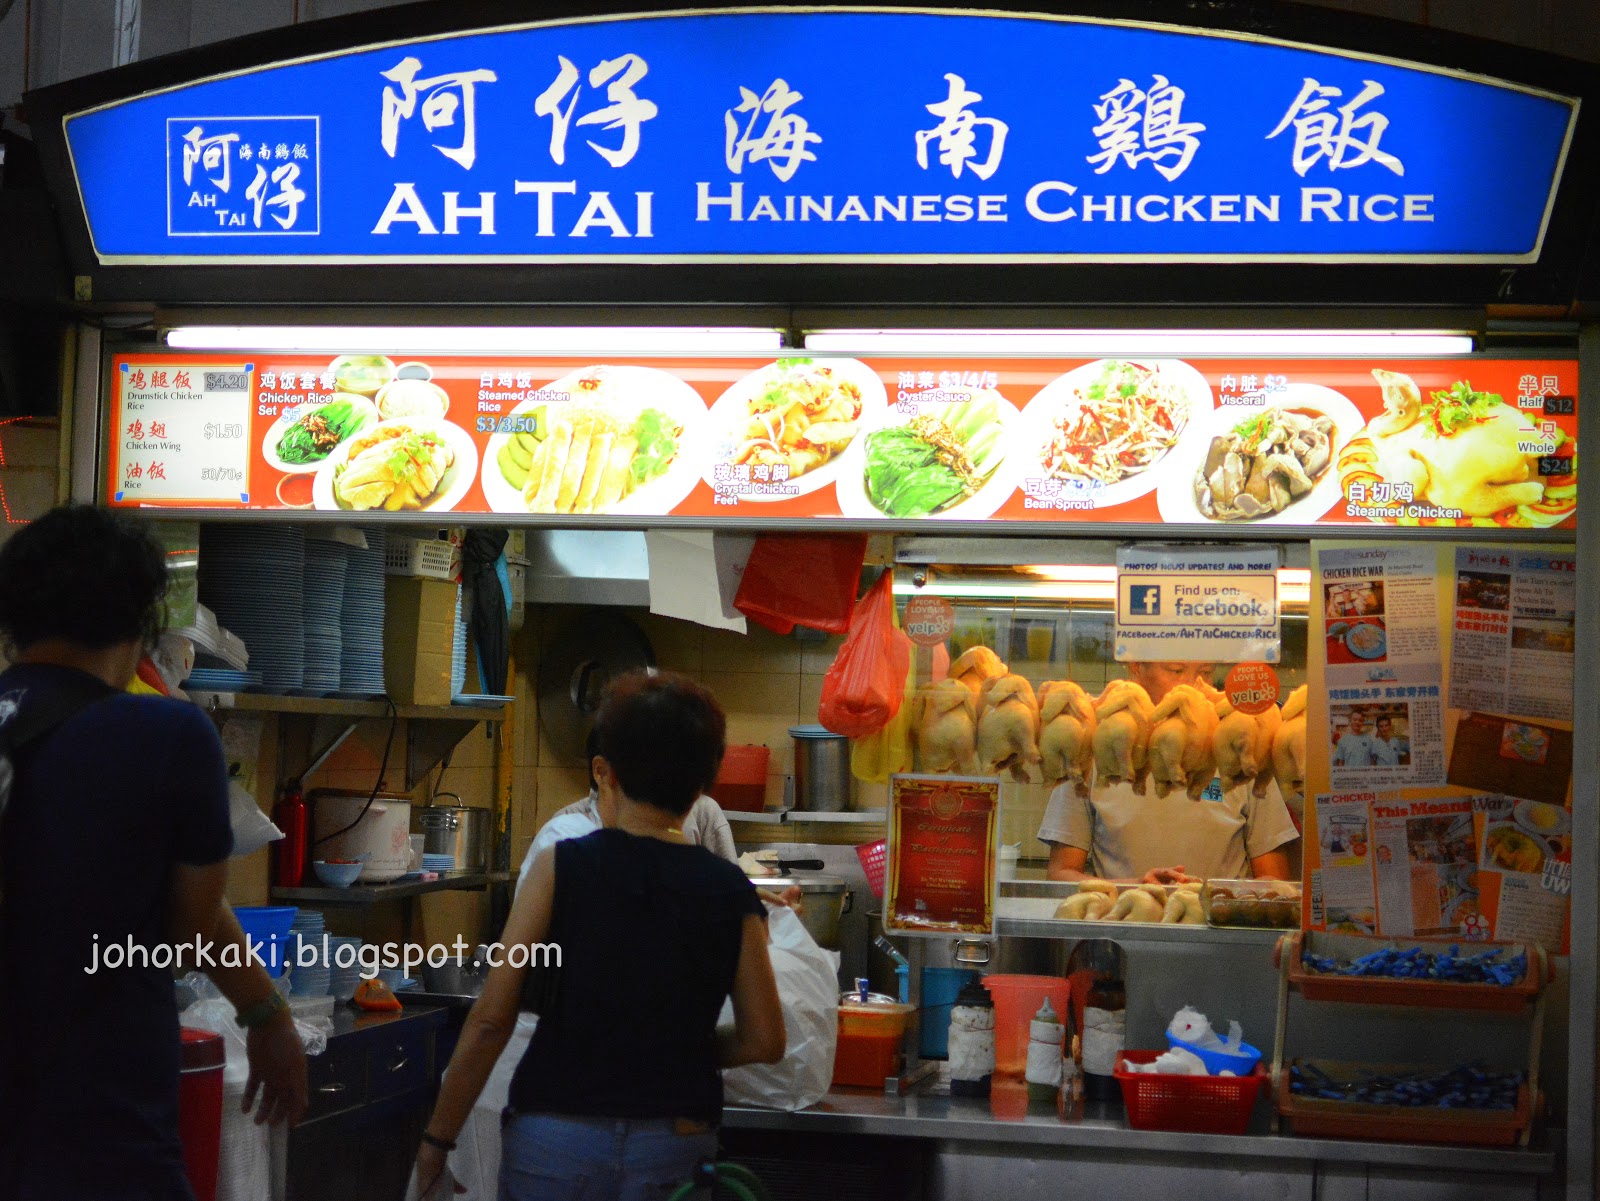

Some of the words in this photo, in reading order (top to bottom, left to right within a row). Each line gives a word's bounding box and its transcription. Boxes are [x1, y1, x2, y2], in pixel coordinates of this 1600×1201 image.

[371, 183, 497, 235] AH
[515, 180, 654, 238] TAI
[695, 182, 1008, 222] HAINANESE
[1025, 180, 1280, 223] CHICKEN
[1300, 187, 1435, 223] RICE
[128, 369, 192, 390] 鸡腿饭
[206, 373, 249, 390] $4.20
[259, 372, 336, 390] 鸡饭套餐
[480, 371, 532, 389] 白鸡饭
[897, 371, 935, 389] 油菜
[1220, 374, 1259, 393] 内脏
[1264, 373, 1287, 394] $2
[1519, 375, 1560, 396] 半只
[127, 392, 168, 400] Drumstick
[170, 392, 203, 400] Chicken
[258, 392, 304, 404] Chicken
[307, 392, 333, 404] Rice
[477, 390, 525, 401] Steamed
[526, 389, 571, 401] Chicken
[897, 391, 934, 403] Oyster
[936, 391, 971, 402] Sauce
[1219, 394, 1265, 406] Visceral
[1519, 396, 1544, 408] Half
[127, 402, 144, 410] Rice
[258, 405, 277, 416] Set
[477, 402, 502, 412] Rice
[896, 402, 918, 416] Veg
[1546, 397, 1574, 413] $12
[281, 406, 301, 423] $5
[126, 419, 168, 440] 鸡翅
[204, 422, 243, 440] $1.50
[476, 416, 537, 433] $3/3.50
[1519, 421, 1557, 441] 一只
[126, 442, 158, 450] Chicken
[160, 442, 181, 452] Wing
[1517, 442, 1555, 453] Whole
[126, 461, 166, 480] 油饭
[714, 463, 790, 481] 玻璃鸡脚
[1541, 458, 1571, 474] $24
[124, 481, 141, 489] Rice
[714, 483, 752, 495] Crystal
[754, 483, 799, 495] Chicken
[1024, 478, 1062, 497] 豆芽
[1347, 482, 1415, 503] 白切鸡
[714, 495, 738, 505] Feet
[1024, 498, 1054, 509] Bean
[1055, 498, 1095, 512] Sprout
[1346, 505, 1405, 519] Steamed
[1407, 505, 1462, 519] Chicken
[1124, 562, 1157, 571] PHOTOS!
[1188, 562, 1224, 571] UPDATES!
[1228, 563, 1244, 571] AND
[1247, 562, 1272, 571] MORE!
[1323, 568, 1351, 580] CHICKEN
[1352, 567, 1367, 578] RICE
[1367, 565, 1385, 577] WAR
[1174, 584, 1200, 596] Find
[1204, 587, 1218, 596] us
[907, 622, 936, 636] yelp
[1237, 665, 1264, 673] PEOPLE
[1233, 673, 1255, 682] LOVE
[1257, 672, 1269, 680] US
[1230, 688, 1261, 705] yelp
[1331, 793, 1376, 804] CHICKEN
[1374, 806, 1408, 818] This
